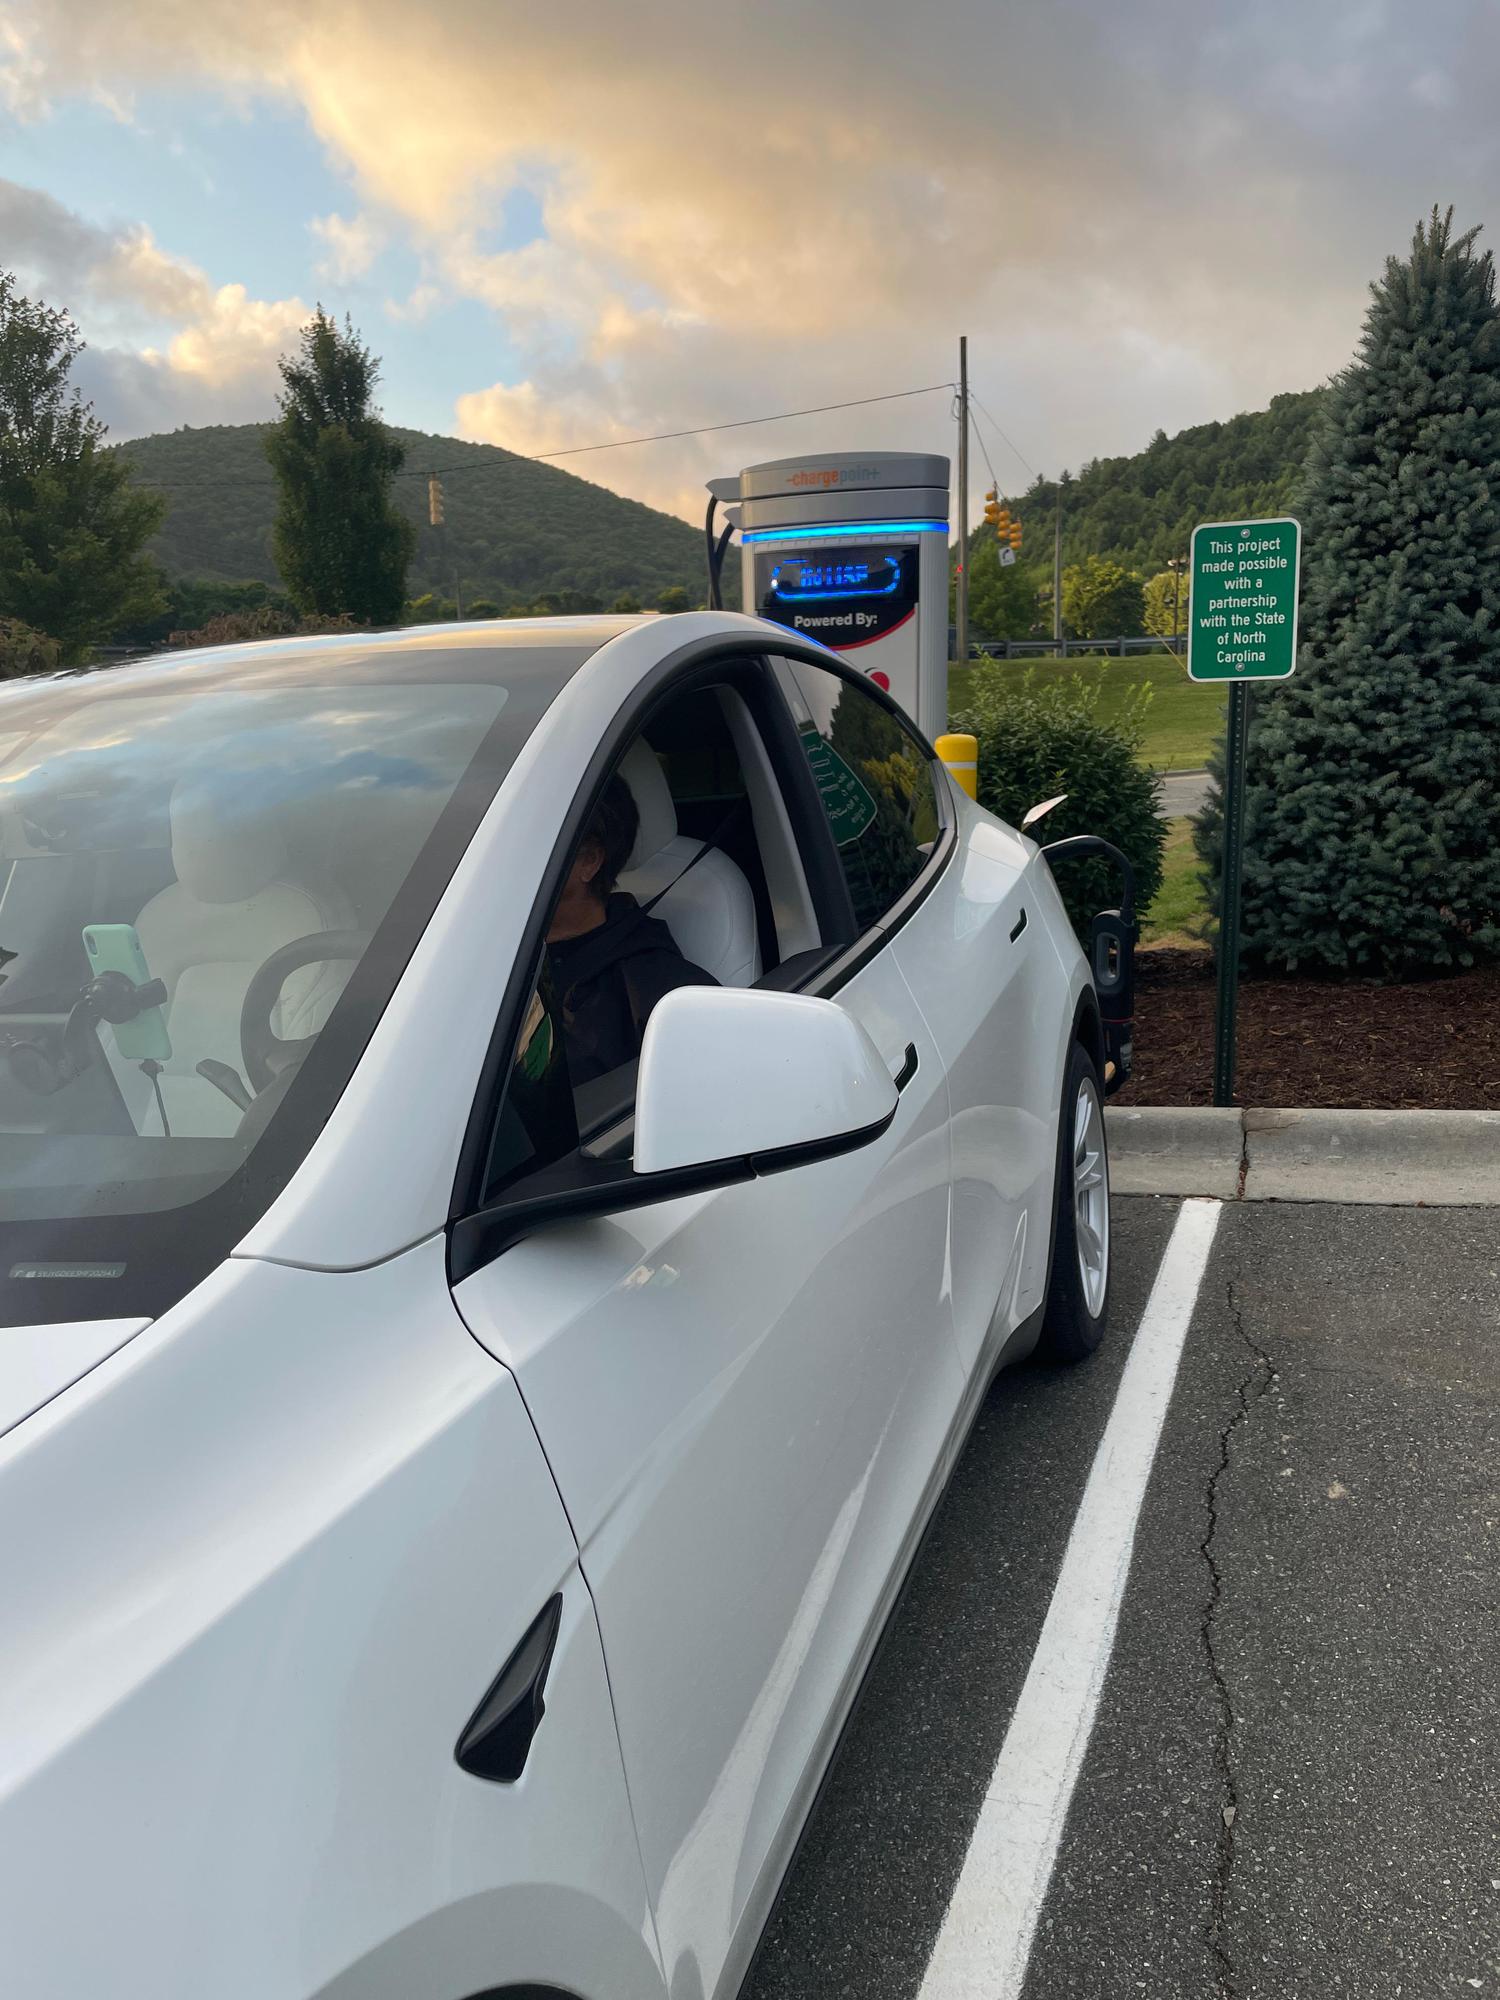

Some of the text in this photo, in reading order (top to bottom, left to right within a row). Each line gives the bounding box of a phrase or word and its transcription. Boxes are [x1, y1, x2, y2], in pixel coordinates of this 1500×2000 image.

[1210, 538, 1281, 555] This project
[1202, 556, 1287, 573] made possible
[1224, 577, 1263, 590] with a
[1209, 594, 1277, 611] partnership
[794, 612, 878, 627] Powered By:
[1200, 612, 1286, 627] with the State
[1217, 632, 1266, 645] of North
[1217, 650, 1266, 663] Carolina
